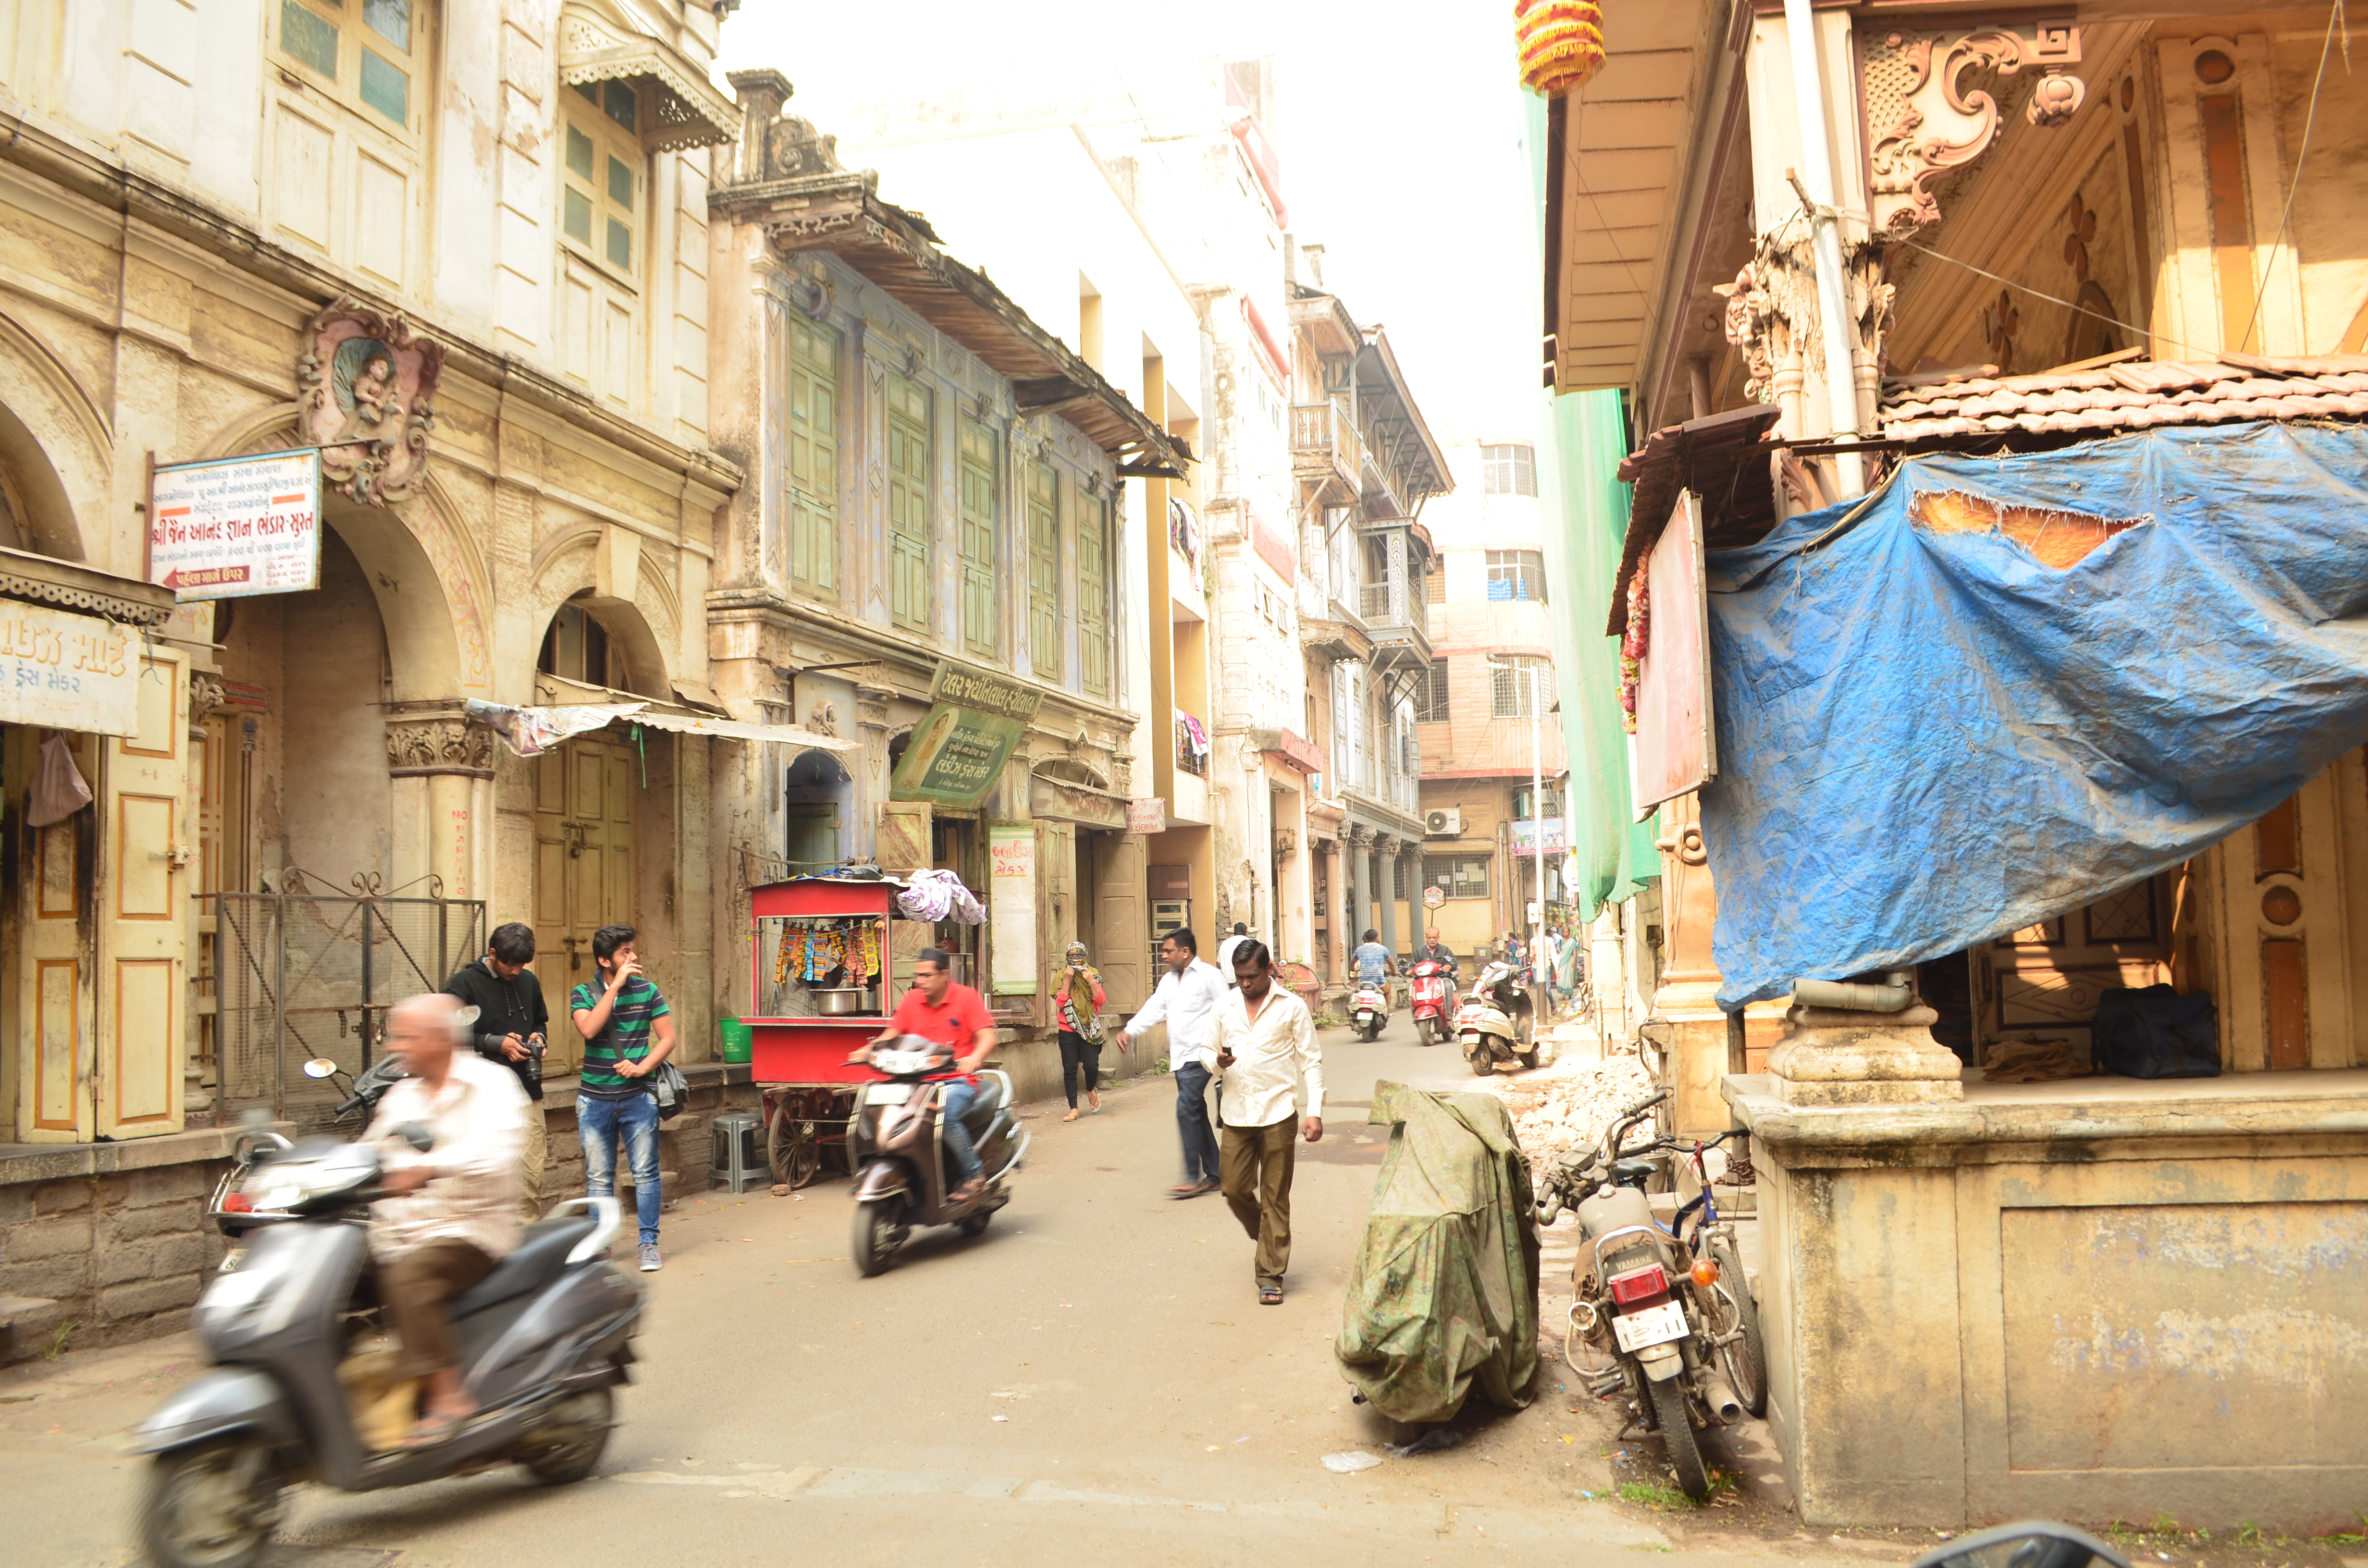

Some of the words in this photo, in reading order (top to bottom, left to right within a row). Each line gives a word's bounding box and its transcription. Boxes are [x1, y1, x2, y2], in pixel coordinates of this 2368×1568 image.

[151, 518, 167, 546] શ્રી
[169, 519, 186, 544] જૈન
[48, 666, 81, 693] મેકર
[451, 810, 468, 820] NO
[456, 825, 466, 895] PARKING
[1616, 1254, 1653, 1272] YAMAHA
